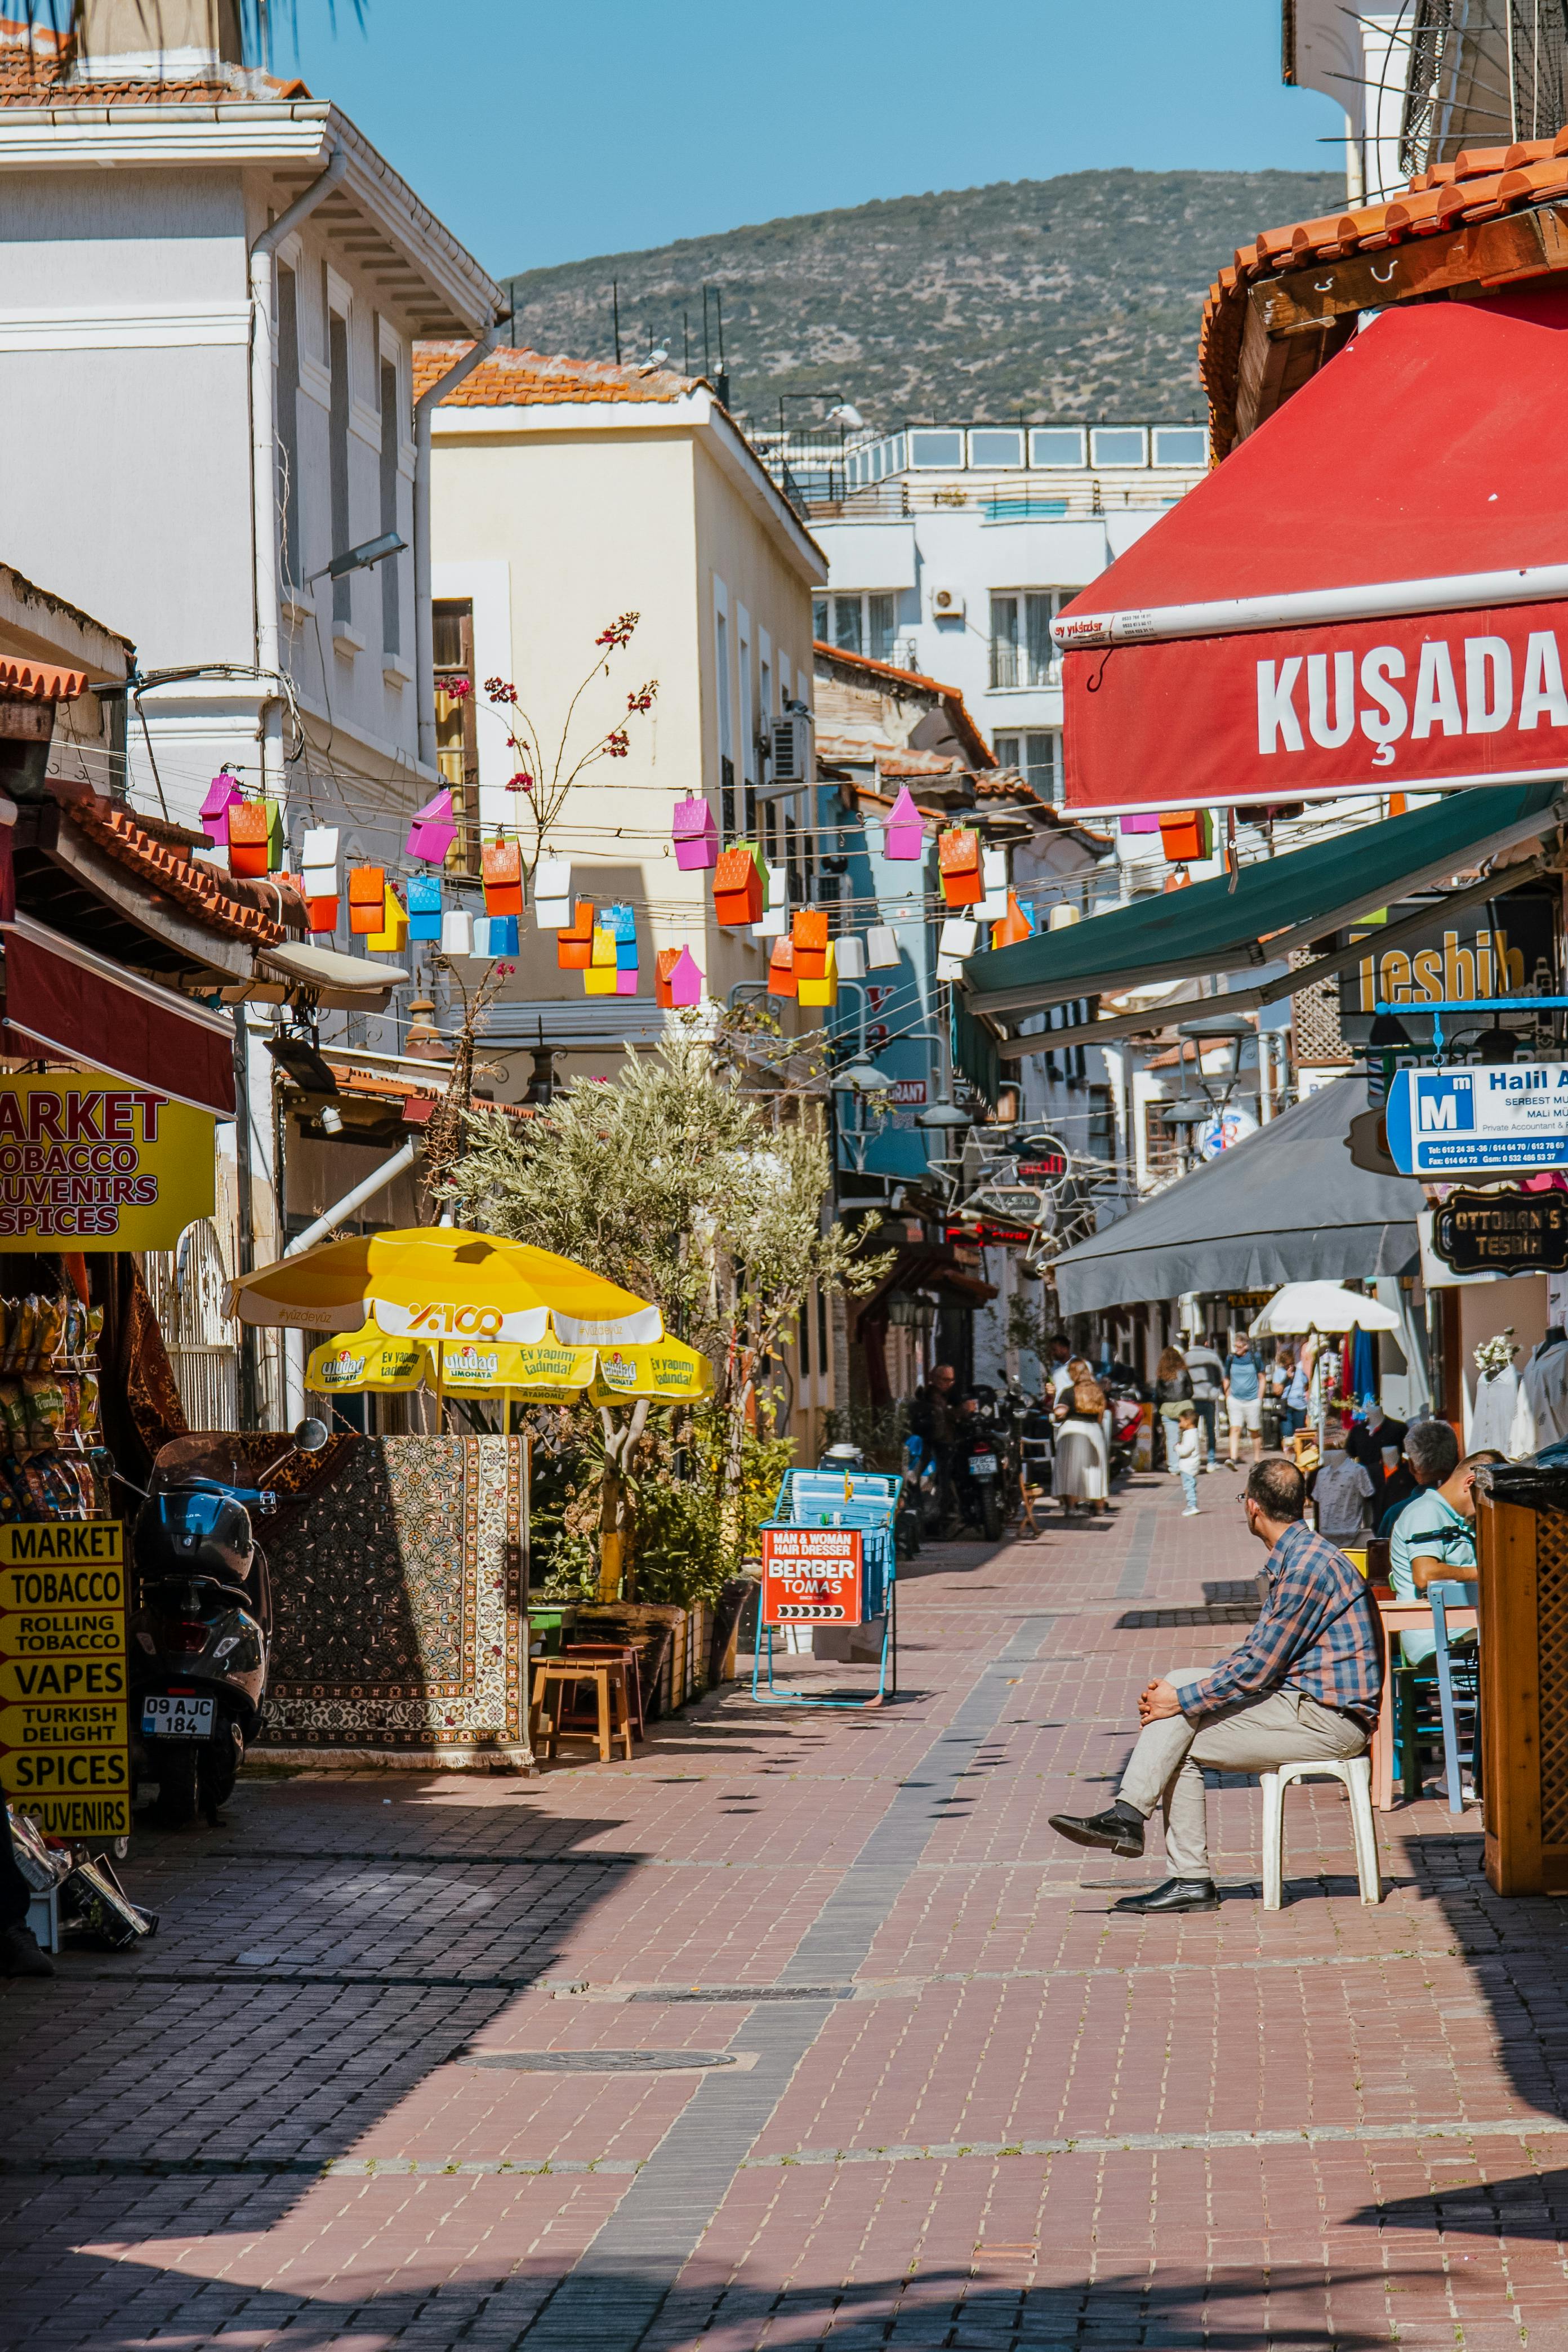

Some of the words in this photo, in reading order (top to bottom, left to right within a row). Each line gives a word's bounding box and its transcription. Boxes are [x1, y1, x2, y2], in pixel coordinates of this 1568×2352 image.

[1257, 630, 1568, 765] KUŞADA
[1490, 1071, 1548, 1090] Halil
[1505, 1097, 1550, 1106] SERBEST
[0, 1175, 158, 1206] UVENIRS
[0, 1206, 119, 1236] SPICES
[382, 1352, 393, 1363] Ev
[443, 1352, 498, 1372] uludağ
[520, 1349, 533, 1362] Ev
[537, 1348, 576, 1362] yapımı
[651, 1358, 660, 1370] Ev
[322, 1356, 366, 1375] uludağ
[525, 1361, 572, 1375] tadında!
[11, 1526, 119, 1558] MARKET
[773, 1533, 798, 1544] MAN
[799, 1533, 807, 1544] &
[809, 1533, 852, 1544] WOMAN
[774, 1544, 799, 1554] HAIR
[801, 1544, 850, 1556] DRESSER
[769, 1558, 855, 1579] BERBER
[11, 1571, 121, 1603] TOBACCO
[781, 1579, 843, 1594] TOMAS
[20, 1615, 114, 1633] ROLLING
[15, 1633, 120, 1651] TOBACCO
[14, 1663, 123, 1694] VAPES
[23, 1707, 117, 1723] TURKISH
[146, 1698, 170, 1714] 09
[175, 1700, 211, 1716] AJC
[23, 1725, 116, 1743] DELIGHT
[167, 1717, 198, 1733] 184
[16, 1754, 126, 1787] SPICES
